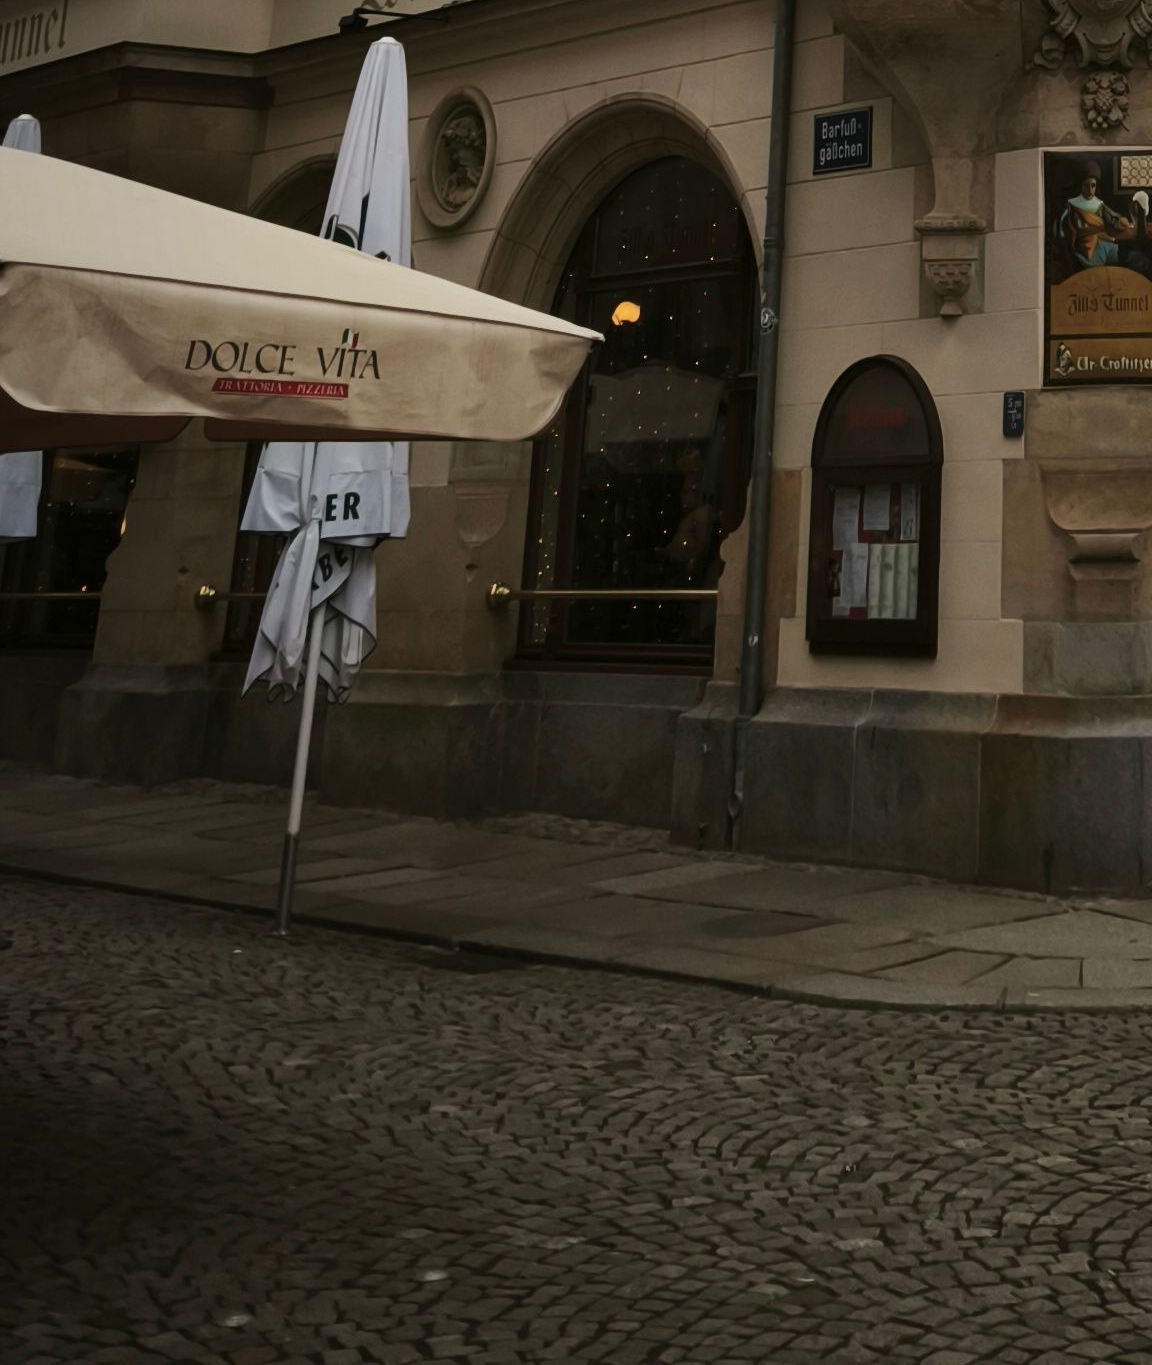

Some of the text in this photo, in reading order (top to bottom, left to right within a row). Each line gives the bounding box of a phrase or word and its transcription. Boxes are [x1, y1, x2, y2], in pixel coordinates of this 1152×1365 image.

[820, 139, 863, 165] gäßchen
[1101, 293, 1149, 311] Tunnel
[185, 340, 380, 380] DOLCE VITA
[218, 379, 345, 397] TRATTORIA PIZZERIA
